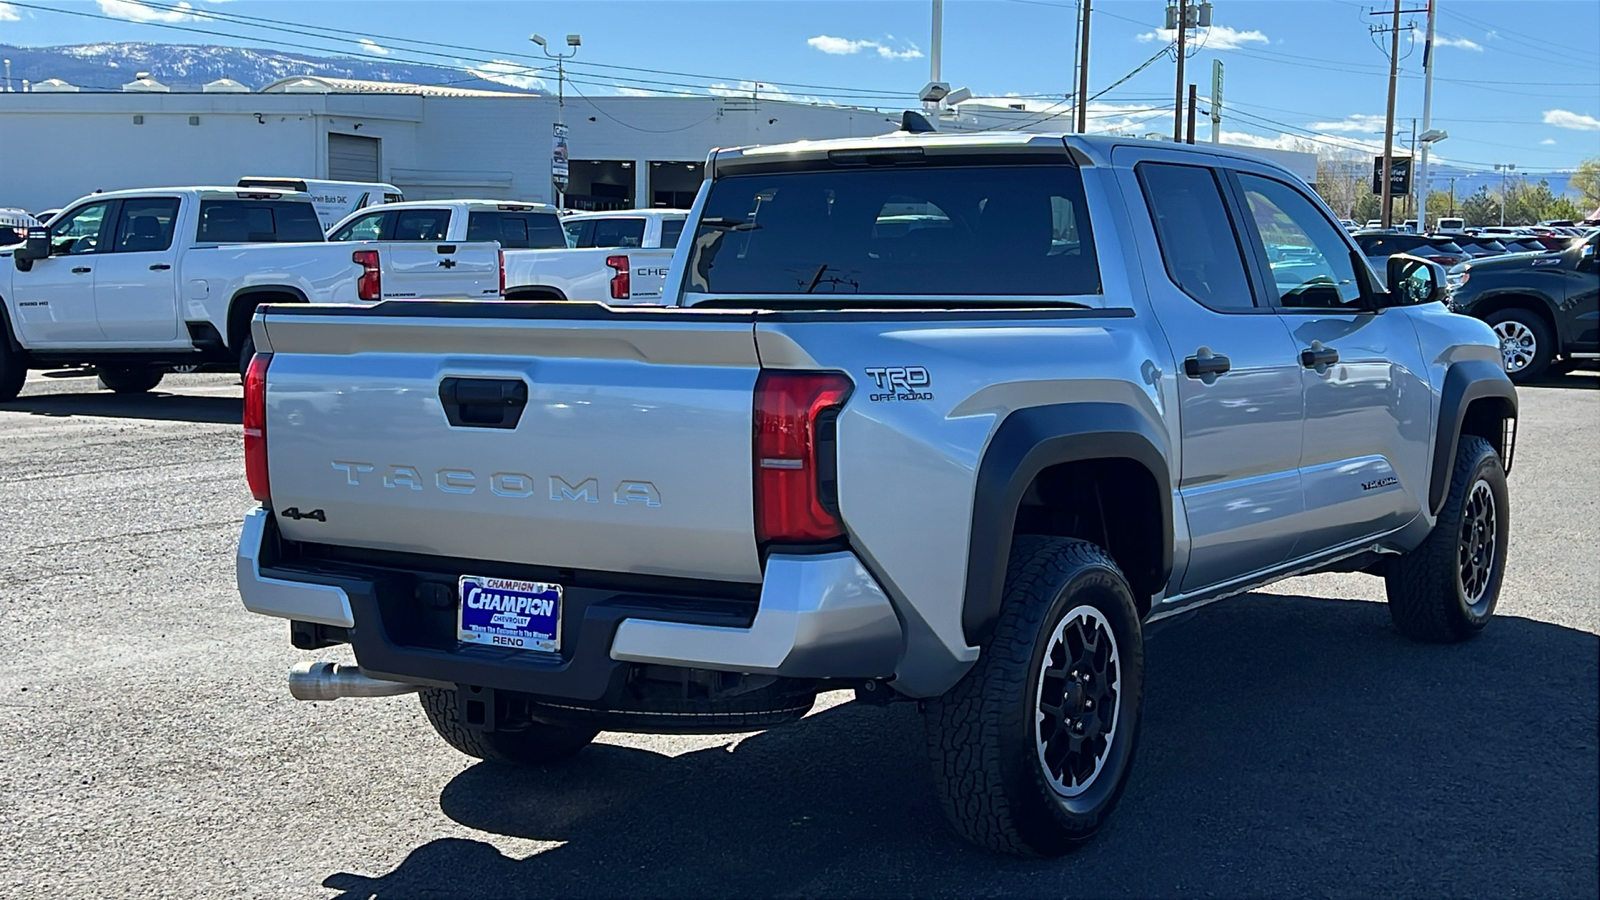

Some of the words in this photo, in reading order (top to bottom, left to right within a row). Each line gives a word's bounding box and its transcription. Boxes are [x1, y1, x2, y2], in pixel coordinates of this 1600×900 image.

[864, 366, 931, 393] TRD
[897, 393, 933, 401] ROAD
[331, 460, 662, 507] TACOMA
[1361, 477, 1398, 490] TACOMA
[487, 579, 534, 591] CHAMPION
[467, 587, 554, 617] CHAMPION
[493, 615, 528, 625] CHEVROLET
[492, 636, 524, 647] RENO
